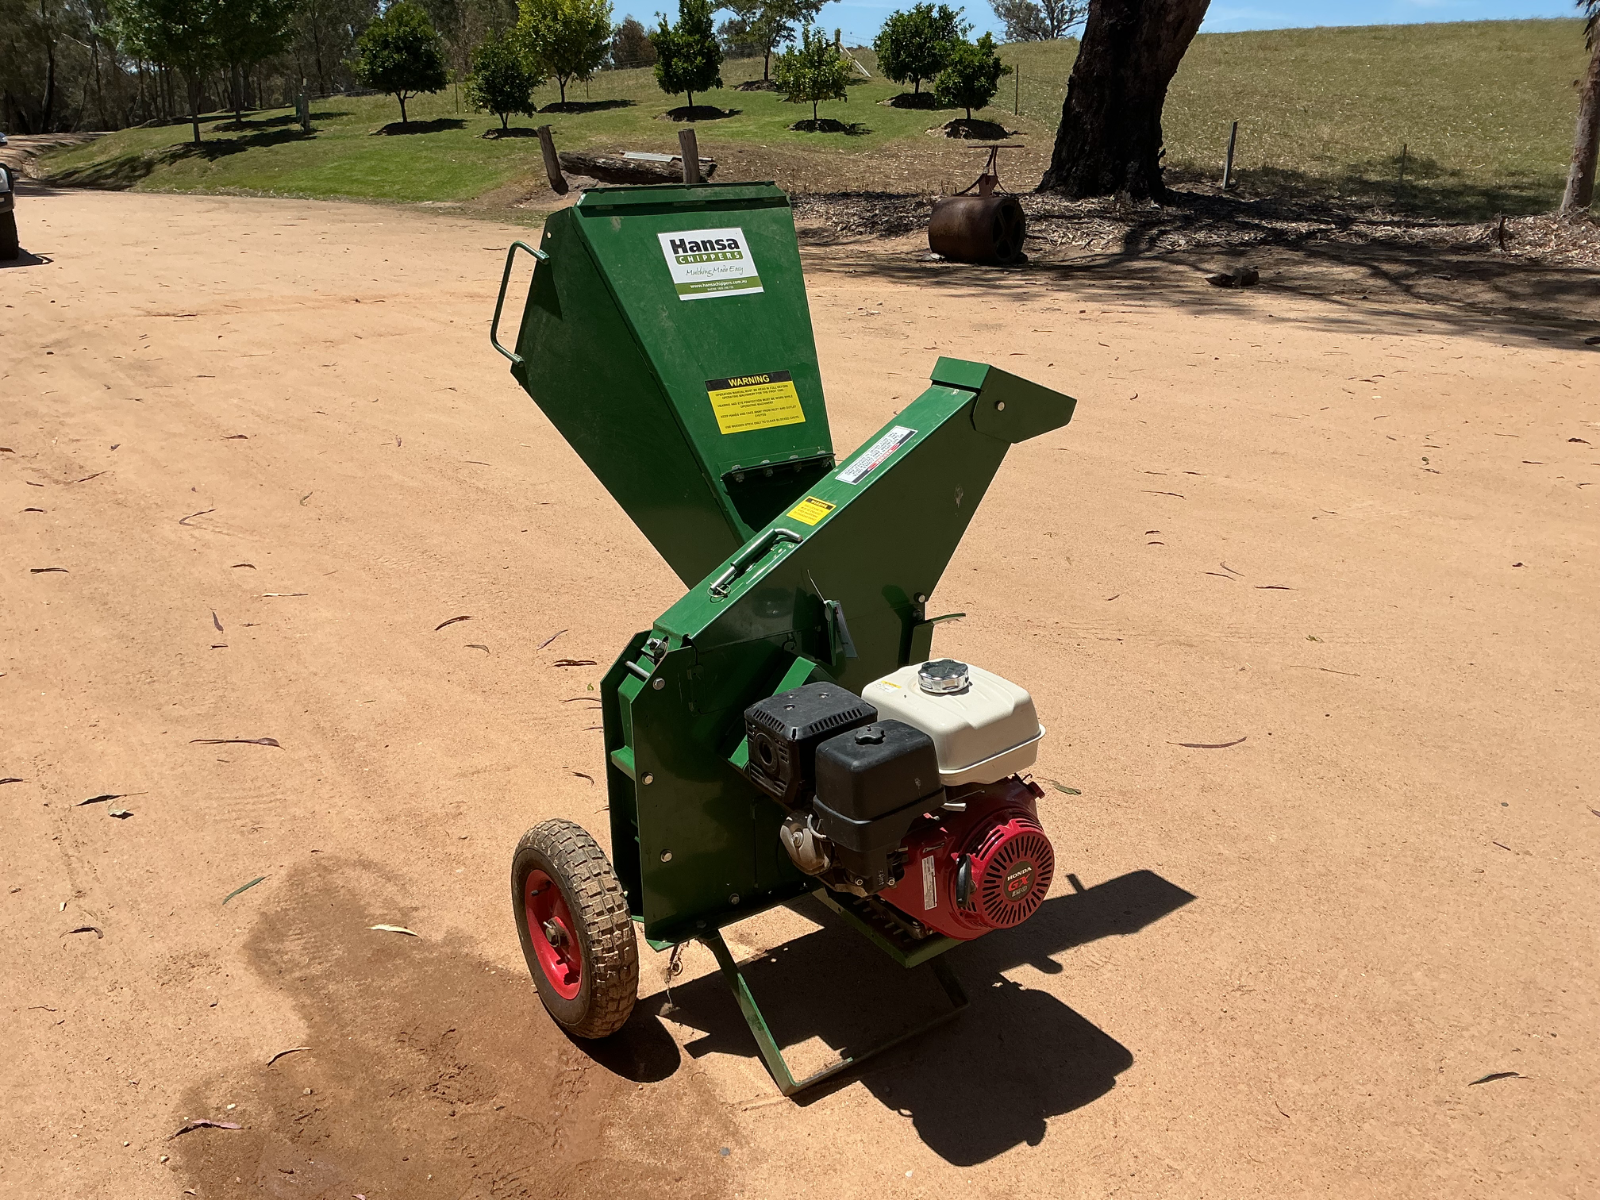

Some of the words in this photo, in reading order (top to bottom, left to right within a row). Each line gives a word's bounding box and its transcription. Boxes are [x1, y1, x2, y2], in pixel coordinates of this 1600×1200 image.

[669, 238, 740, 255] Hansa
[679, 252, 740, 263] CHIPPERS
[729, 265, 744, 275] Easy
[690, 280, 747, 288] www.hansachippers.com.au
[728, 375, 770, 387] WARNING
[1007, 866, 1032, 881] HONDA
[1008, 873, 1031, 892] GX
